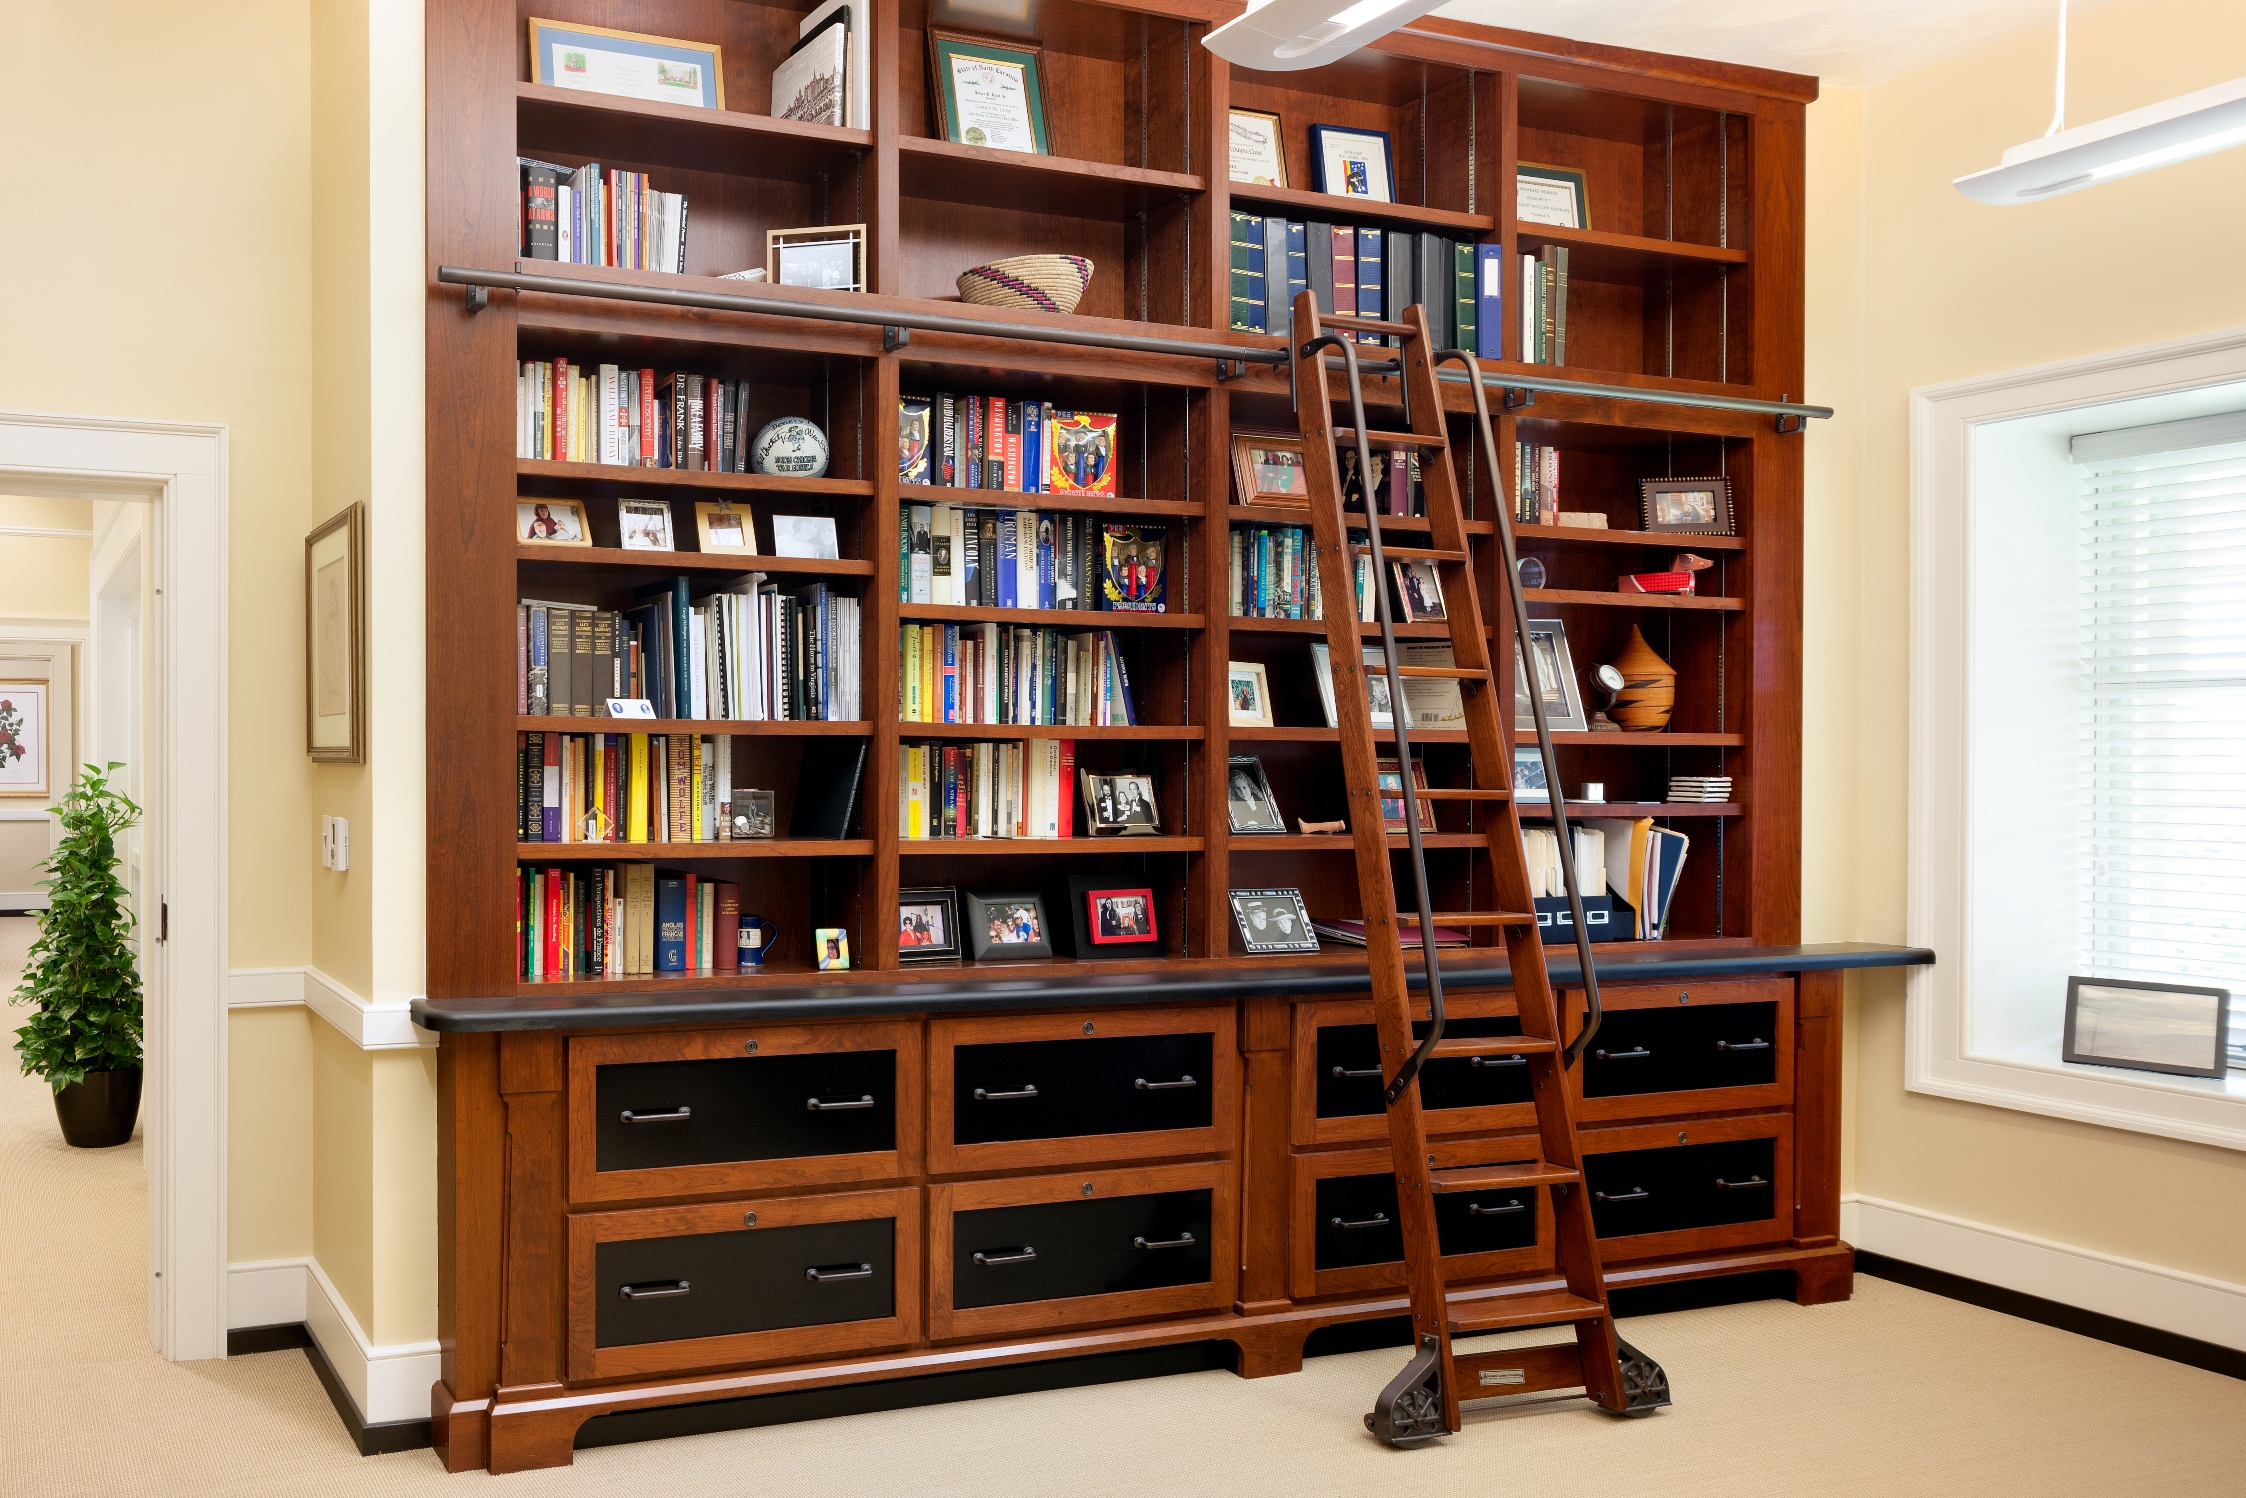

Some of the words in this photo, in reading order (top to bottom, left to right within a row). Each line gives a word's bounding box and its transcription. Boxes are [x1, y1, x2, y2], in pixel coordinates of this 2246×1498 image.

[533, 185, 555, 198] WORLD
[568, 370, 577, 410] Regionalism
[676, 374, 686, 390] DR.
[569, 411, 577, 424] and
[676, 395, 686, 430] FRANK
[688, 400, 703, 416] LIKE
[943, 398, 954, 416] DAVID
[569, 426, 577, 437] the
[689, 423, 703, 450] FAMILY
[993, 402, 1003, 453] WASHINGTON
[569, 438, 577, 457] South
[1007, 437, 1017, 484] WASHINGTON
[901, 509, 909, 531] DANIEL
[965, 529, 979, 569] LINCOLN
[1004, 515, 1017, 559] TRUMAN
[1085, 535, 1092, 545] AT
[1292, 578, 1300, 605] South
[676, 738, 687, 770] TOM
[678, 776, 687, 833] WOLFE
[595, 883, 603, 926] Perspectives
[597, 928, 603, 936] de
[596, 937, 604, 962] France
